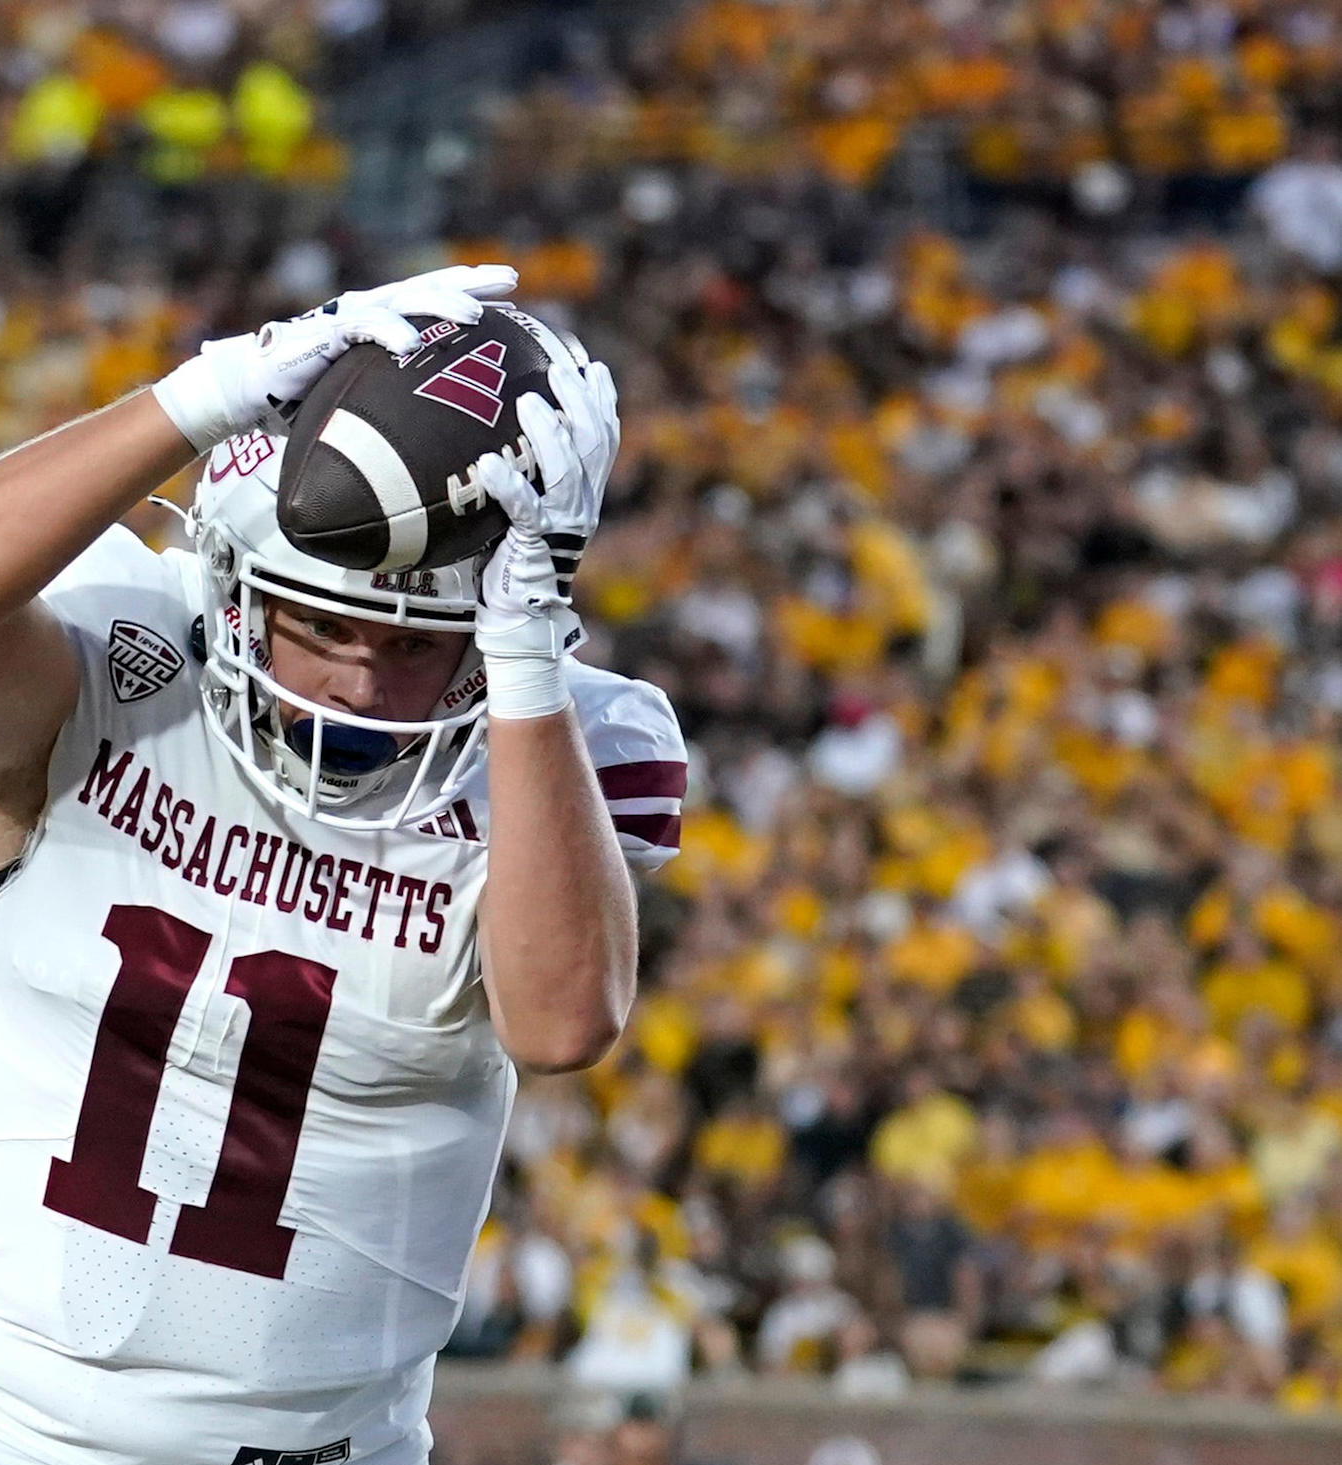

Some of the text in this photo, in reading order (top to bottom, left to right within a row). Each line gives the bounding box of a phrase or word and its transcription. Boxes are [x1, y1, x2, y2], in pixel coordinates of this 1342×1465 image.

[109, 638, 174, 684] MAC
[77, 738, 453, 954] MASSACHUSETTS
[42, 903, 339, 1281] 11
